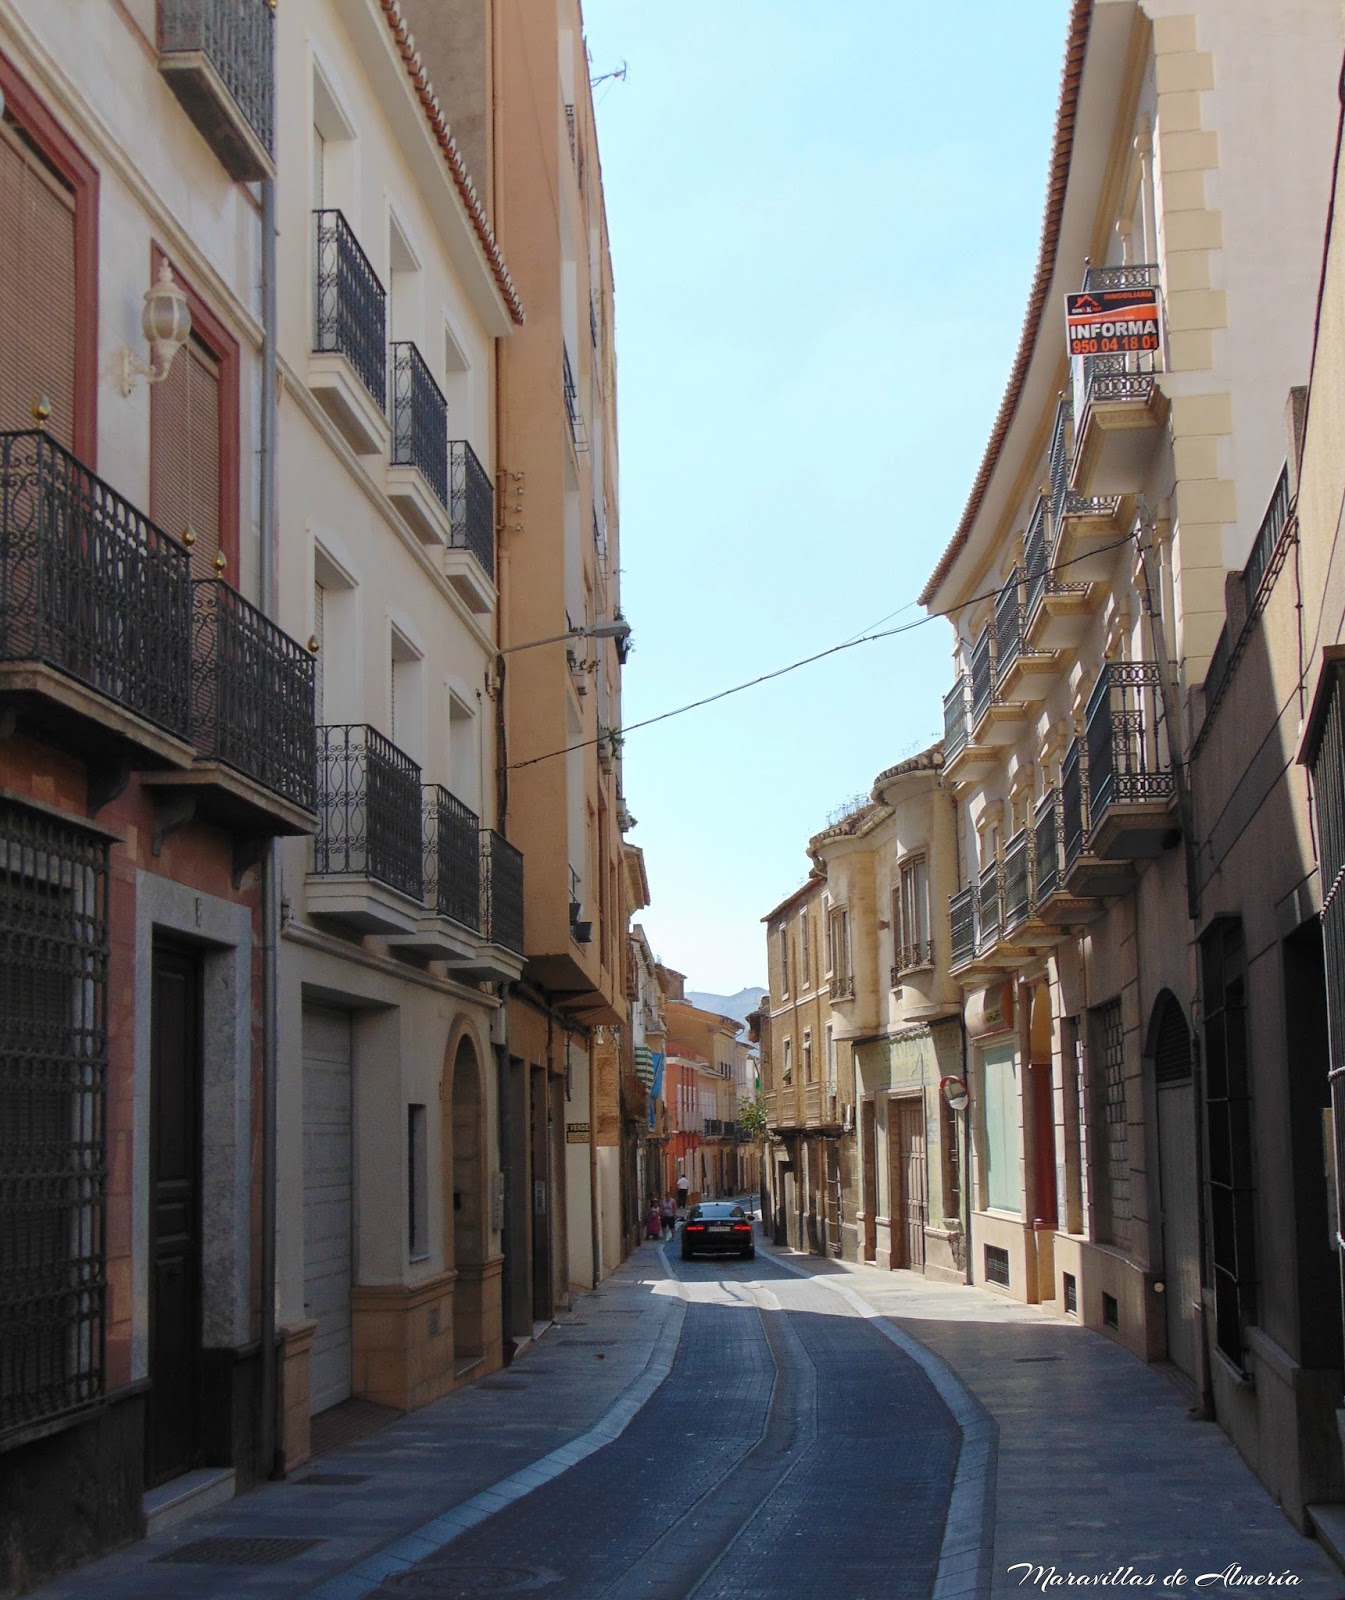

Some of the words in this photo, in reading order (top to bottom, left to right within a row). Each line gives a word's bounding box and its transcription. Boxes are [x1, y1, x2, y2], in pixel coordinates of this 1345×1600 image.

[1070, 319, 1157, 340] INFORMA
[1072, 339, 1098, 354] 950
[1101, 337, 1119, 352] 04
[1122, 335, 1139, 350] 18
[1142, 334, 1158, 349] 01
